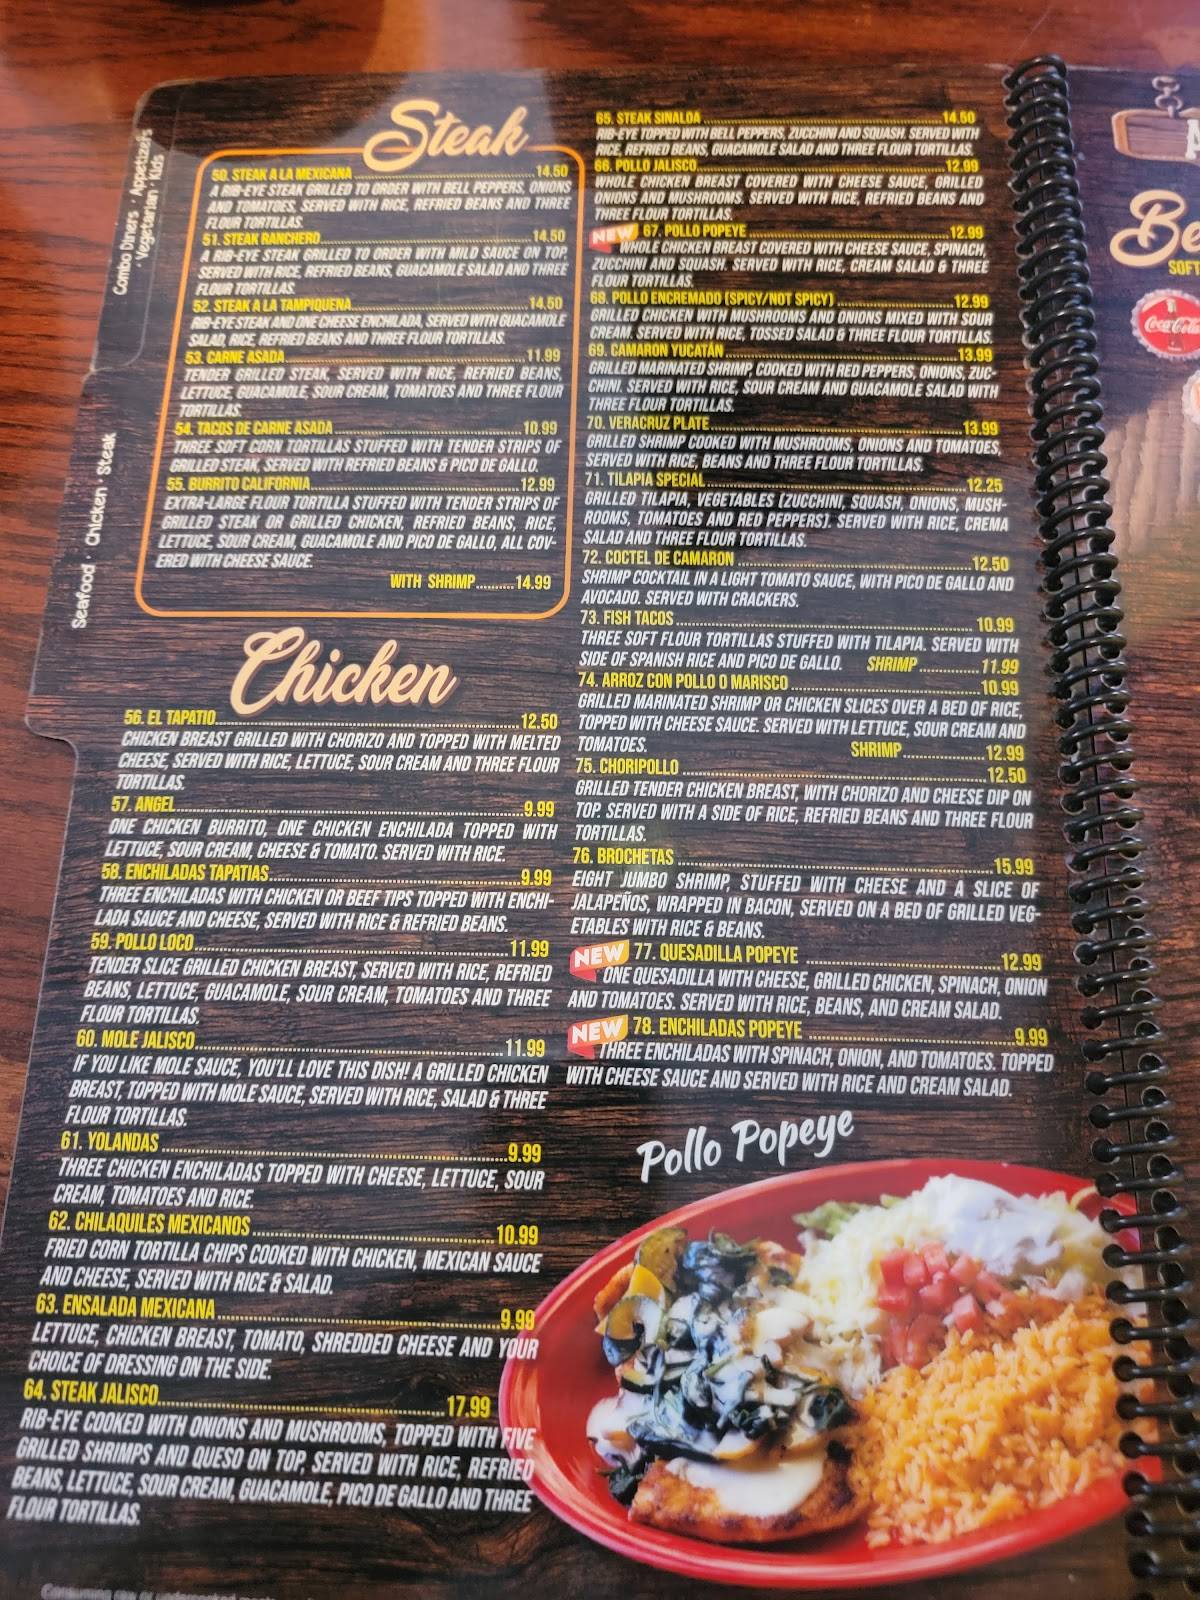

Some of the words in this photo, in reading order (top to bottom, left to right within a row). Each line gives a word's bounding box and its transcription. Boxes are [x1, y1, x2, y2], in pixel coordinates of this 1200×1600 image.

[363, 99, 530, 173] Steak
[129, 129, 153, 197] Appetizers
[232, 168, 266, 180] STEAK
[268, 168, 277, 180] A
[278, 168, 293, 180] LA
[537, 164, 568, 177] 14.50
[615, 158, 650, 172] POLLO
[654, 158, 698, 171] JALISCO
[946, 159, 979, 172] 12.99
[135, 189, 159, 260] Vegetarian
[148, 153, 165, 181] Kids
[120, 210, 140, 251] Diners
[592, 223, 634, 244] NEW
[642, 223, 660, 237] 67.
[664, 223, 700, 237] POLLO
[702, 223, 746, 237] POPEYE
[950, 225, 983, 239] 12.99
[113, 253, 133, 297] Combo
[611, 290, 648, 304] POLLO
[651, 290, 722, 304] ENCREMADO
[724, 291, 791, 305] (SPICY/NOT
[795, 292, 834, 306] SPICY)
[954, 294, 989, 308] 12.99
[185, 351, 202, 364] 53.
[206, 350, 244, 364] CARNE
[247, 349, 284, 363] ASADA
[527, 347, 561, 362] 11.99
[588, 342, 607, 357] 69.
[610, 343, 668, 356] CAMARON
[672, 343, 723, 357] YUCATÁN
[958, 347, 993, 362] 13.99
[587, 415, 605, 429] 70.
[609, 415, 669, 430] VERACRUZ
[673, 416, 708, 430] PLATE
[963, 420, 998, 435] 13.99
[166, 477, 183, 491] 55.
[188, 476, 239, 490] BURRITO
[242, 476, 309, 490] CALIFORNIA
[520, 476, 555, 492] 12.99
[585, 471, 604, 486] 71.
[609, 471, 653, 486] TILAPIA
[656, 472, 704, 487] SPECIAL
[967, 477, 1003, 492] 12.25
[71, 563, 96, 629] Seafood
[84, 487, 108, 547] Chicken
[96, 432, 117, 476] Steak
[583, 549, 601, 564] 72.
[605, 549, 650, 565] COCTEL
[654, 550, 670, 565] DE
[673, 550, 734, 566] CAMARON
[972, 556, 1009, 571] 12.50
[390, 573, 422, 588] WITH
[428, 573, 475, 589] SHRIMP
[516, 574, 551, 590] 14.99
[581, 609, 600, 624] 73.
[603, 609, 631, 625] FISH
[636, 610, 673, 625] TACOS
[977, 617, 1014, 632] 10.99
[581, 629, 622, 646] THREE
[624, 630, 656, 646] SOFT
[660, 631, 701, 646] FLOUR
[707, 631, 773, 648] TORTILLAS
[777, 633, 833, 649] STUFFED
[837, 634, 871, 650] WITH
[875, 635, 926, 651] TILAPIA.
[931, 636, 982, 652] SERVED
[985, 637, 1019, 653] WITH
[230, 626, 458, 716] Chicken
[867, 656, 917, 672] SHRIMP
[983, 658, 1019, 674] 11.99
[579, 671, 598, 687] 74.
[602, 672, 643, 688] ARROZ
[646, 672, 672, 688] CON
[675, 673, 716, 689] POLLO
[718, 673, 728, 689] O
[730, 674, 788, 690] MARISCO
[981, 679, 1019, 696] 10.99
[124, 709, 144, 725] 56.
[147, 709, 162, 725] EL
[167, 709, 217, 725] TAPATIO
[521, 713, 558, 729] 12.50
[576, 757, 595, 773] 75.
[600, 757, 678, 775] CHORIPOLLO
[989, 766, 1026, 783] 12.50
[111, 795, 131, 812] 57.
[134, 795, 174, 812] ANGEL
[522, 800, 554, 817] 9.99
[573, 846, 594, 864] 76.
[597, 847, 673, 865] BROCHETAS
[996, 857, 1034, 875] 15.99
[101, 863, 120, 879] 58.
[125, 863, 205, 880] ENCHILADAS
[210, 864, 268, 881] TAPATIAS
[518, 868, 552, 886] 9.99
[90, 932, 111, 949] 59.
[115, 932, 157, 950] POLLO
[159, 933, 194, 951] LOCO
[512, 939, 549, 957] 11.99
[574, 943, 625, 968] NEW
[635, 942, 657, 960] 77.
[660, 943, 742, 962] QUESADILLA
[745, 945, 797, 963] POPEYE
[1003, 953, 1042, 971] 12.99
[76, 1029, 96, 1047] 60.
[101, 1030, 139, 1048] MOLE
[142, 1031, 195, 1049] JALISCO
[507, 1038, 545, 1057] 11.99
[572, 1017, 624, 1045] NEW
[634, 1016, 656, 1034] 78.
[659, 1017, 745, 1037] ENCHILADAS
[749, 1019, 801, 1039] POPEYE
[1014, 1027, 1048, 1046] 9.99
[566, 1066, 603, 1084] WITH
[605, 1067, 659, 1086] CHEESE
[662, 1068, 708, 1088] SAUCE
[710, 1070, 741, 1089] AND
[743, 1071, 798, 1090] SERVED
[801, 1072, 839, 1092] WITH
[841, 1074, 874, 1093] RICE
[876, 1075, 907, 1094] AND
[910, 1076, 960, 1095] CREAM
[963, 1077, 1013, 1096] SALAD.
[60, 1130, 82, 1150] 61.
[89, 1131, 158, 1152] YOLANDAS
[508, 1143, 541, 1163] 9.99
[636, 1126, 722, 1183] Pollo
[730, 1110, 854, 1167] Popeye
[53, 1184, 104, 1204] CREAM,
[111, 1186, 185, 1206] TOMATOES
[186, 1187, 218, 1207] AND
[219, 1188, 253, 1209] RICE.
[48, 1211, 71, 1230] 62.
[75, 1212, 164, 1233] CHILAQUILES
[168, 1214, 249, 1235] MEXICANOS
[498, 1224, 538, 1245] 10.99
[36, 1294, 58, 1313] 63.
[63, 1295, 136, 1316] ENSALADA
[500, 1309, 535, 1330] 9.99
[23, 1380, 45, 1399] 64.
[51, 1381, 97, 1402] STEAK
[102, 1382, 158, 1404] JALISCO
[448, 1396, 491, 1417] 17.99
